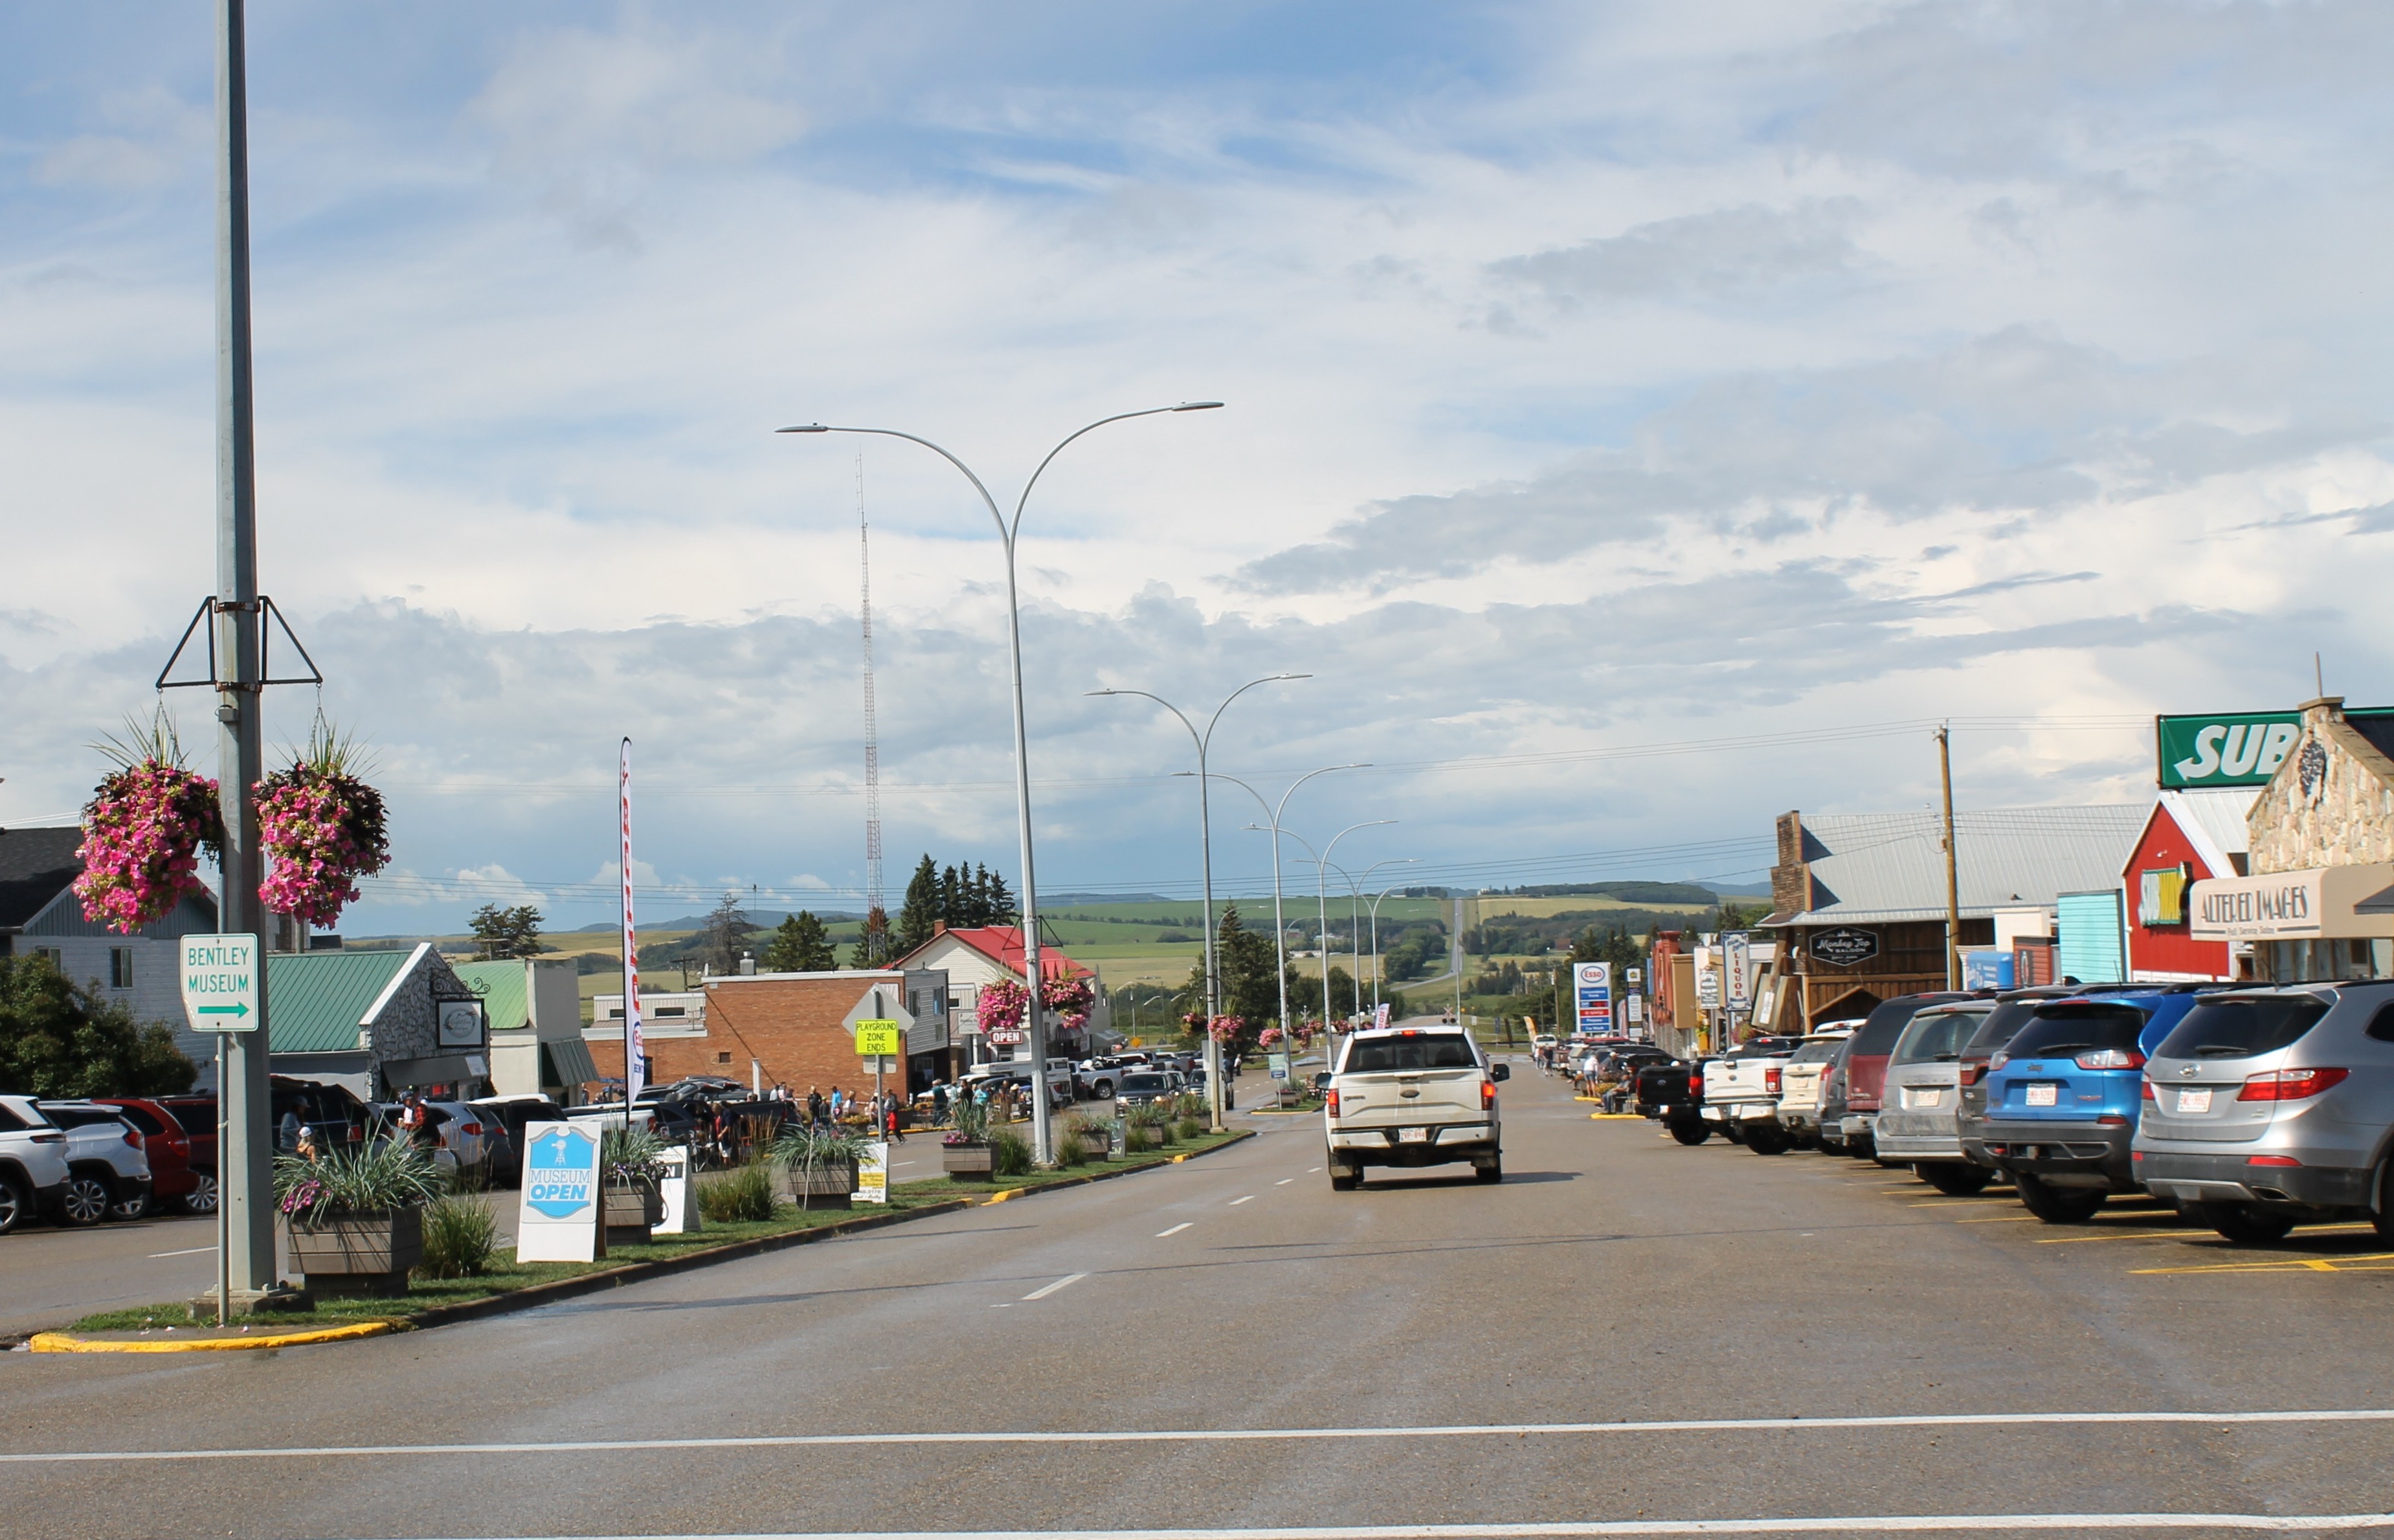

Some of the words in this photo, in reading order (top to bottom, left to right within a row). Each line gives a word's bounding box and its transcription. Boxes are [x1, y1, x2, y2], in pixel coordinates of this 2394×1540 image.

[2138, 865, 2186, 926] SUBWAY
[2202, 892, 2253, 922] ALTERED
[2255, 885, 2308, 921] IMAGES
[2239, 926, 2258, 935] Service
[2259, 926, 2275, 934] Salon
[1817, 939, 1853, 952] Monkey
[188, 947, 249, 966] BENTLEY
[1734, 953, 1743, 996] LIQUOR
[188, 974, 249, 992] MUSEUM
[992, 1032, 1020, 1042] OPEN
[530, 1170, 590, 1183] MUSEUM
[531, 1185, 587, 1200] OPEN
